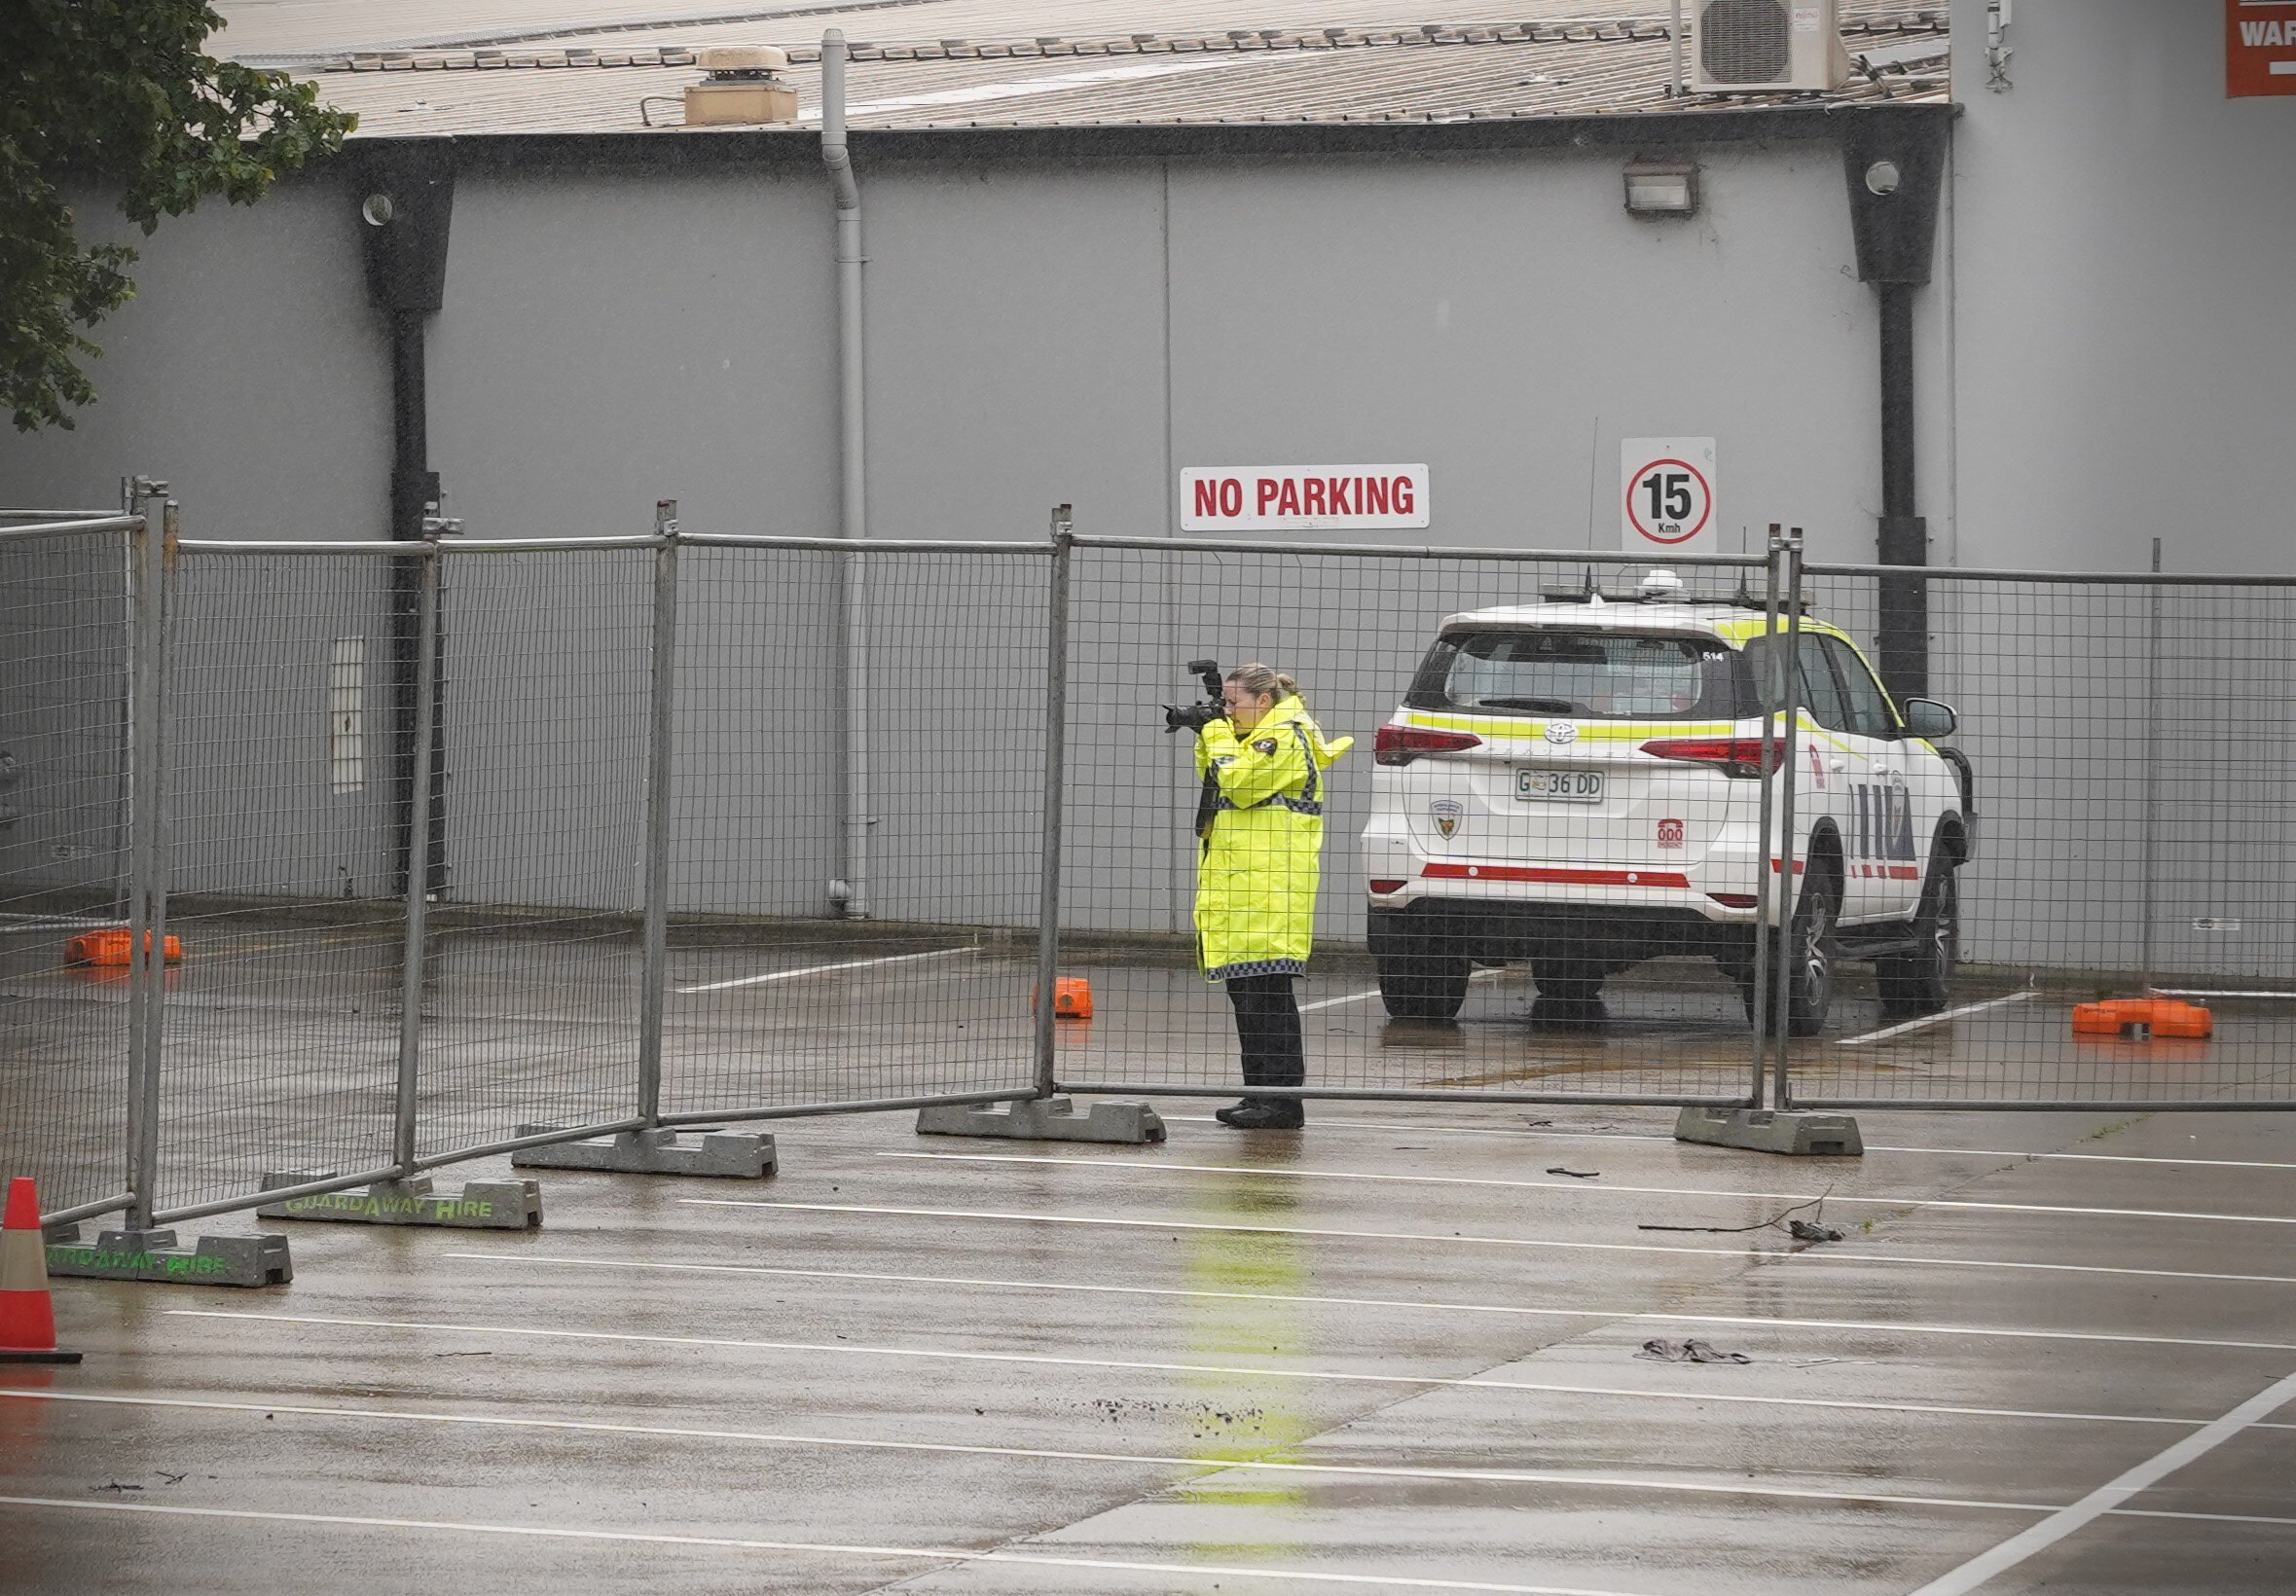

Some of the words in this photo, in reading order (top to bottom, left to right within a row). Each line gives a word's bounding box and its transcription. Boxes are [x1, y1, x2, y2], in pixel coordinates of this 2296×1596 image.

[1194, 478, 1243, 518] NO
[1257, 475, 1415, 517] PARKING
[1642, 473, 1692, 521] 15
[1658, 522, 1681, 534] Kmh
[1518, 771, 1531, 792] G
[1549, 773, 1571, 794] 36
[1576, 774, 1601, 795] DD
[1658, 828, 1683, 841] 000
[435, 1199, 493, 1219] HIRE
